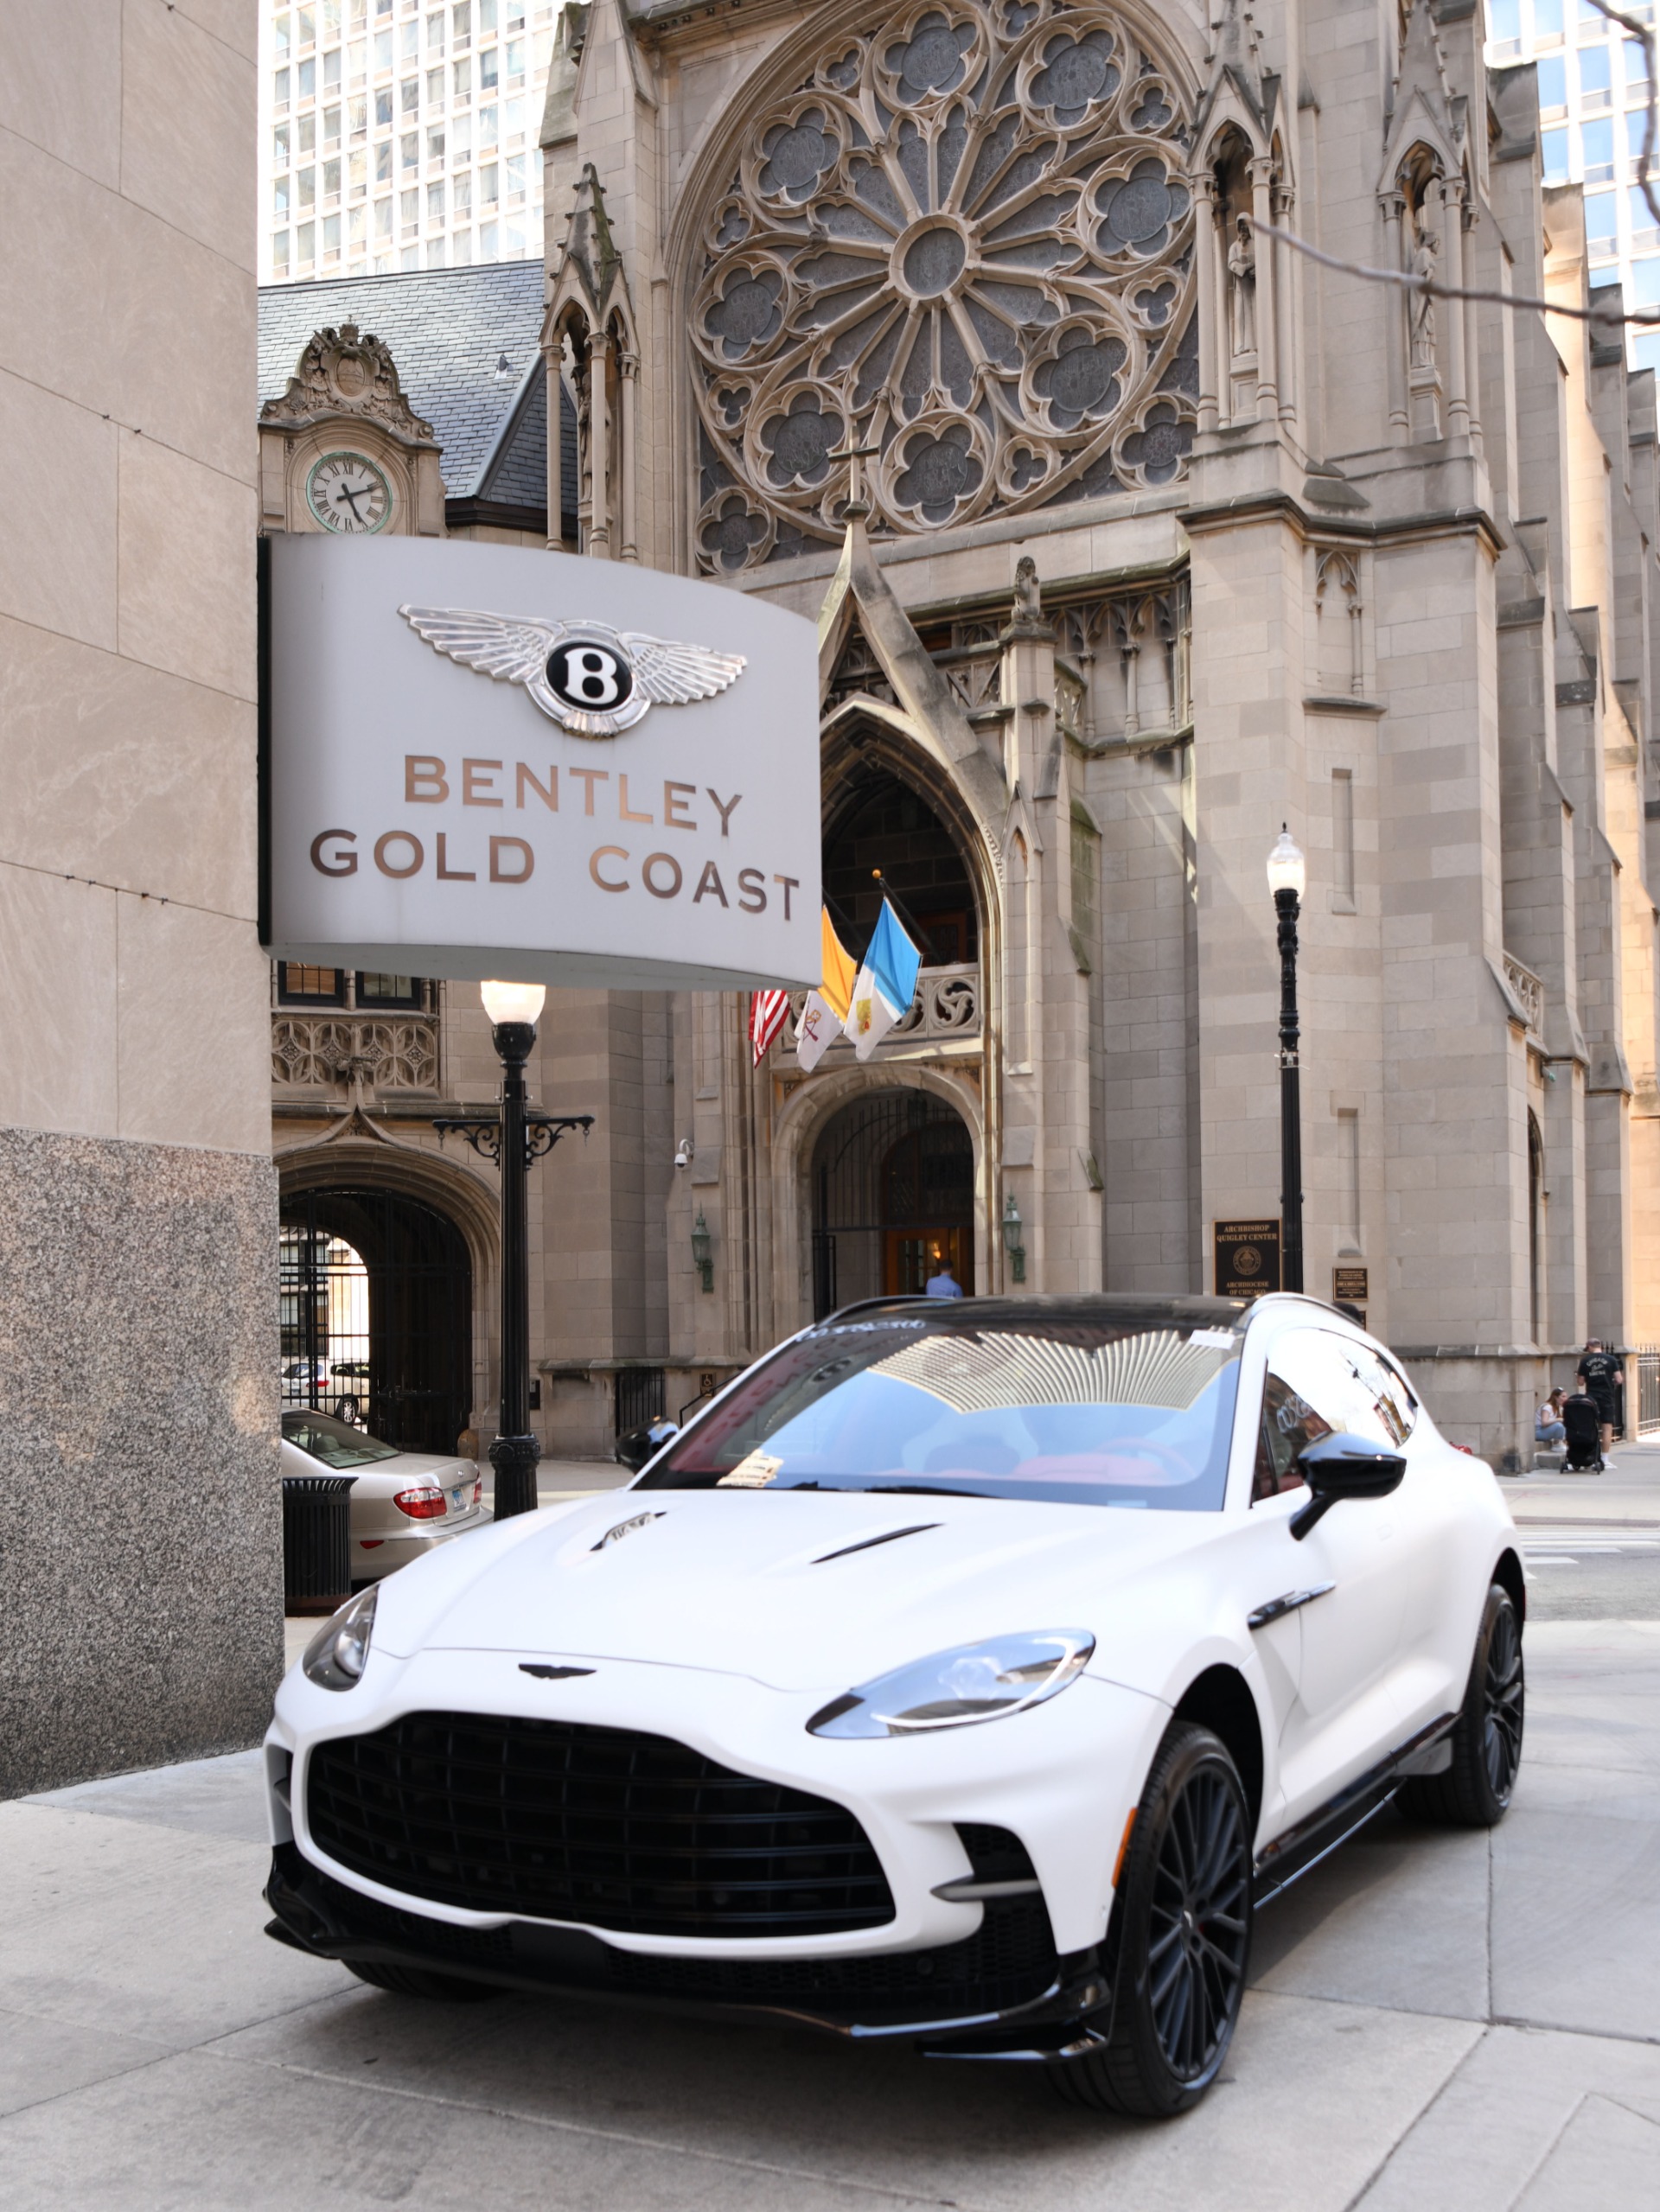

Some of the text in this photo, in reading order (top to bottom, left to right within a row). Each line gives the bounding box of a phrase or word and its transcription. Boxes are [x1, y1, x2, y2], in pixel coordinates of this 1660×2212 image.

[564, 646, 619, 706] B
[404, 754, 744, 838] BENTLEY
[309, 828, 800, 921] GOLD COAST
[1216, 1233, 1278, 1243] QUIGLEY CENTER
[1223, 1224, 1270, 1233] ARCHBISHOP
